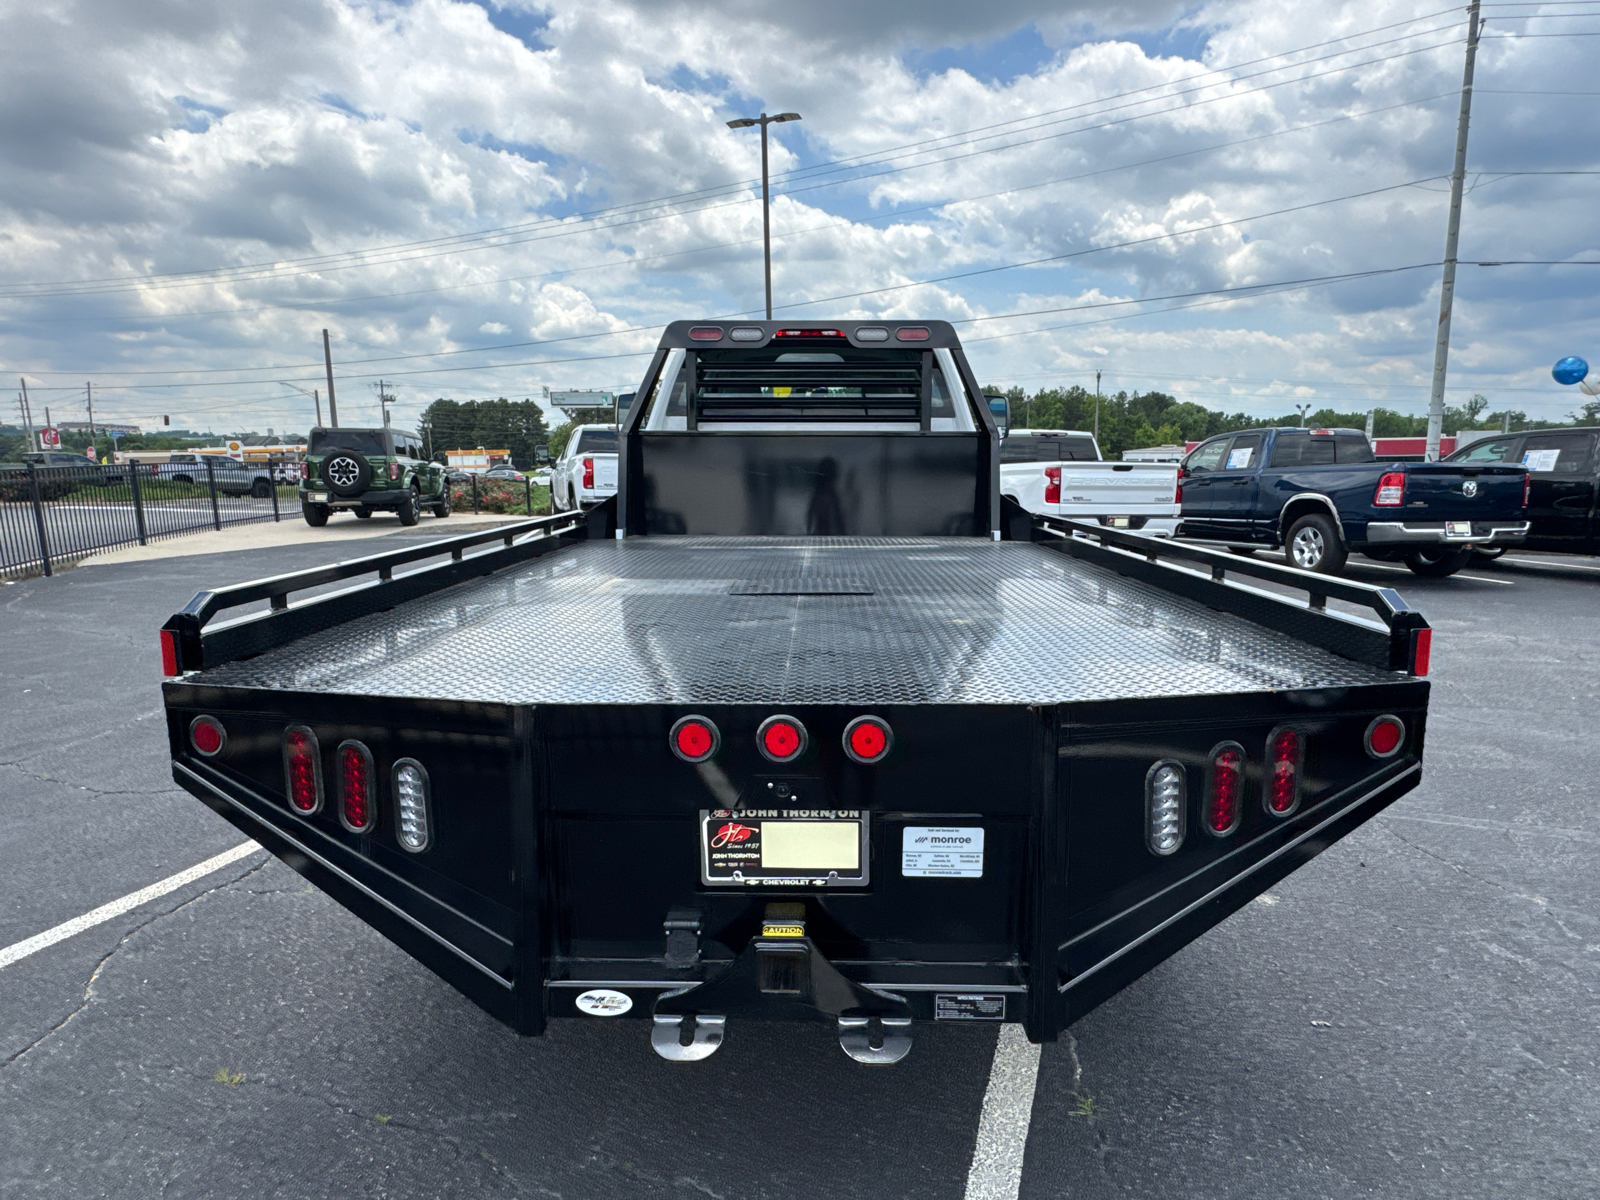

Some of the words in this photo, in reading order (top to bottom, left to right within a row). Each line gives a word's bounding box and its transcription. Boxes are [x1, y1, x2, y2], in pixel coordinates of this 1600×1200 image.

[739, 809, 778, 818] JOHN
[930, 836, 972, 844] monroe
[763, 926, 803, 934] CAUTION
